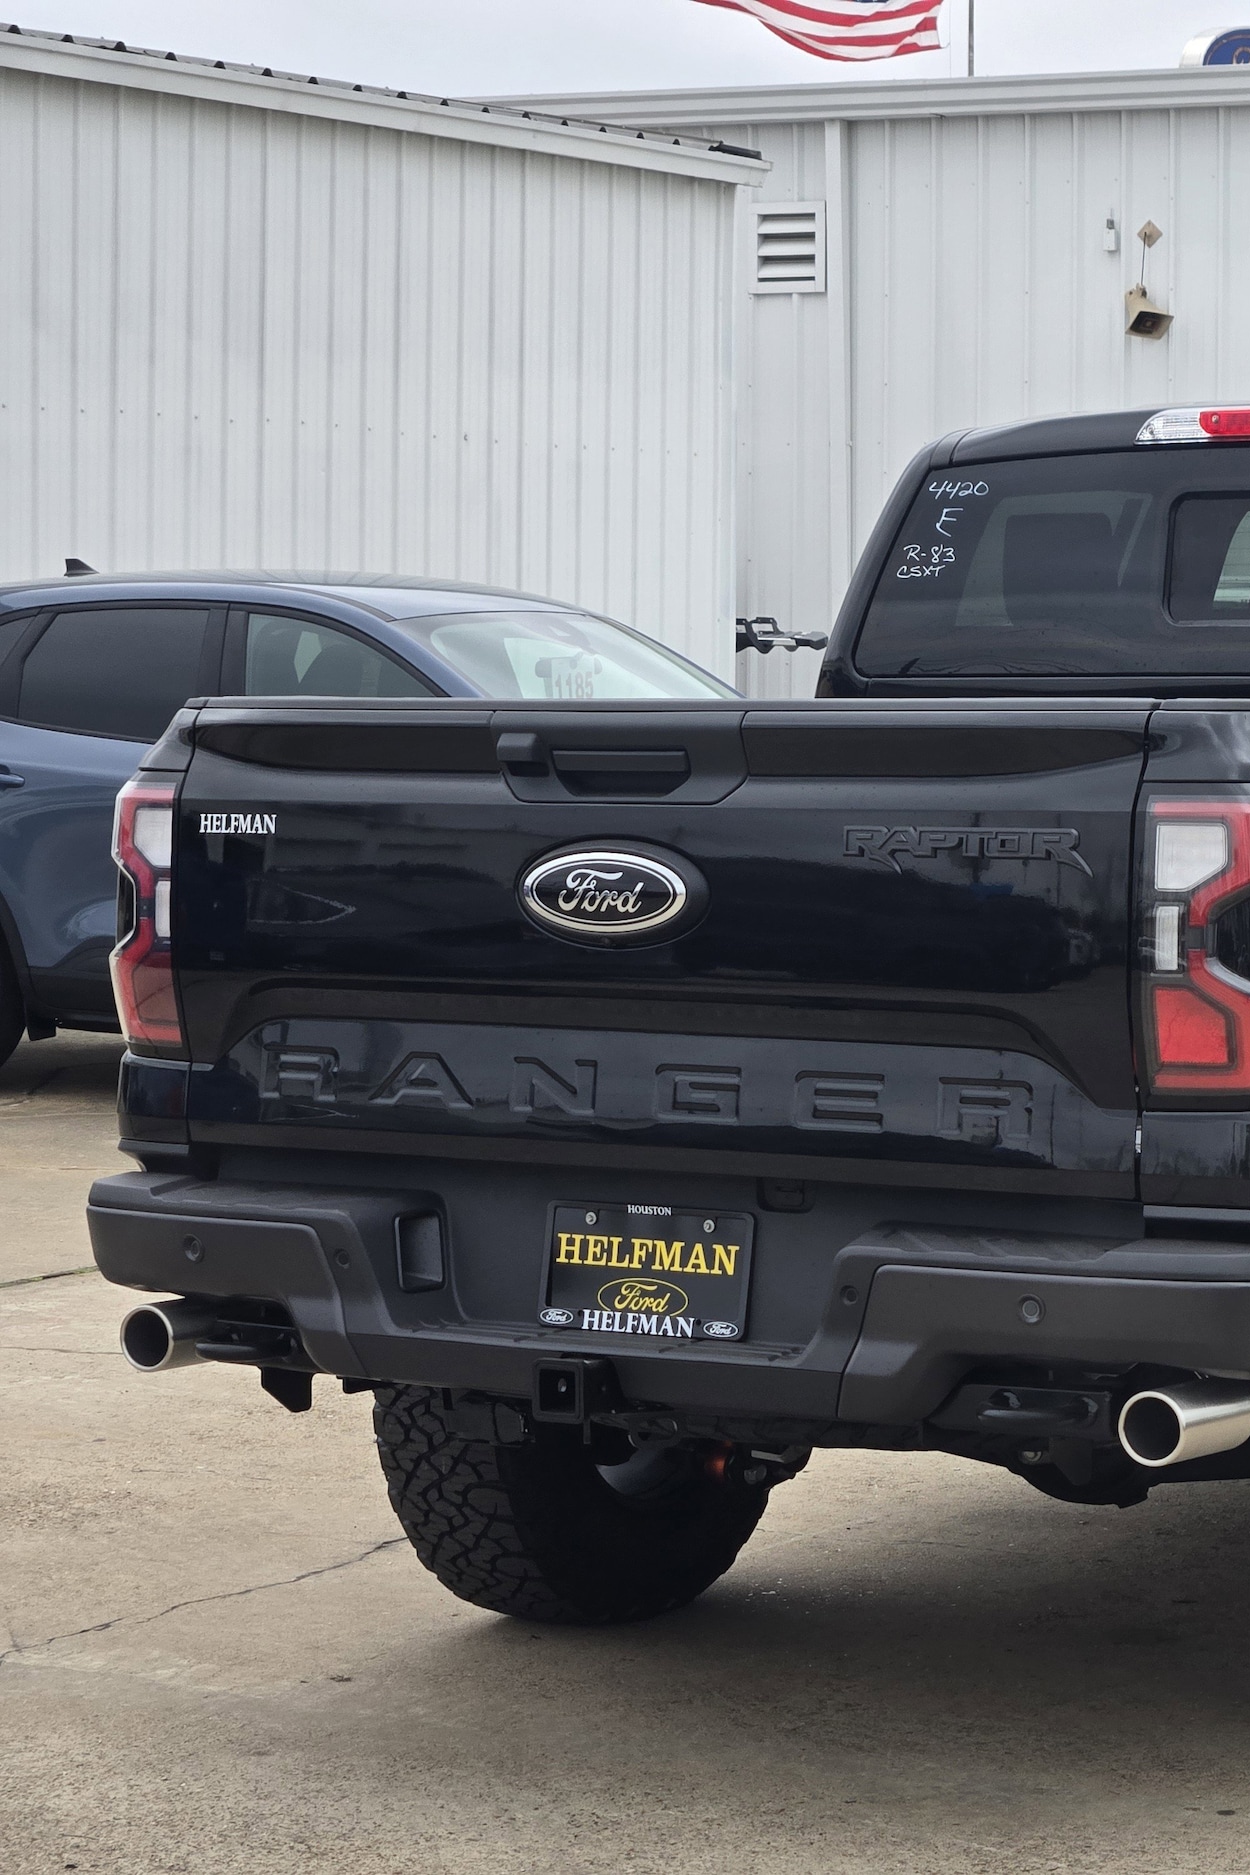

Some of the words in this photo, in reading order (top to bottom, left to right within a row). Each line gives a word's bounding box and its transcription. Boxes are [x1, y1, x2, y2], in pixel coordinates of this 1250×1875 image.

[929, 480, 989, 500] 4420
[555, 671, 594, 699] 1185
[199, 813, 278, 834] HELFMAN
[843, 826, 1094, 878] RAPTOR
[558, 868, 645, 913] Ford
[259, 1042, 1034, 1142] RANGER
[627, 1204, 673, 1217] HOUSTON
[555, 1232, 741, 1276] HELFMAN
[613, 1281, 671, 1313] Ford
[580, 1308, 696, 1339] HELFMAN
